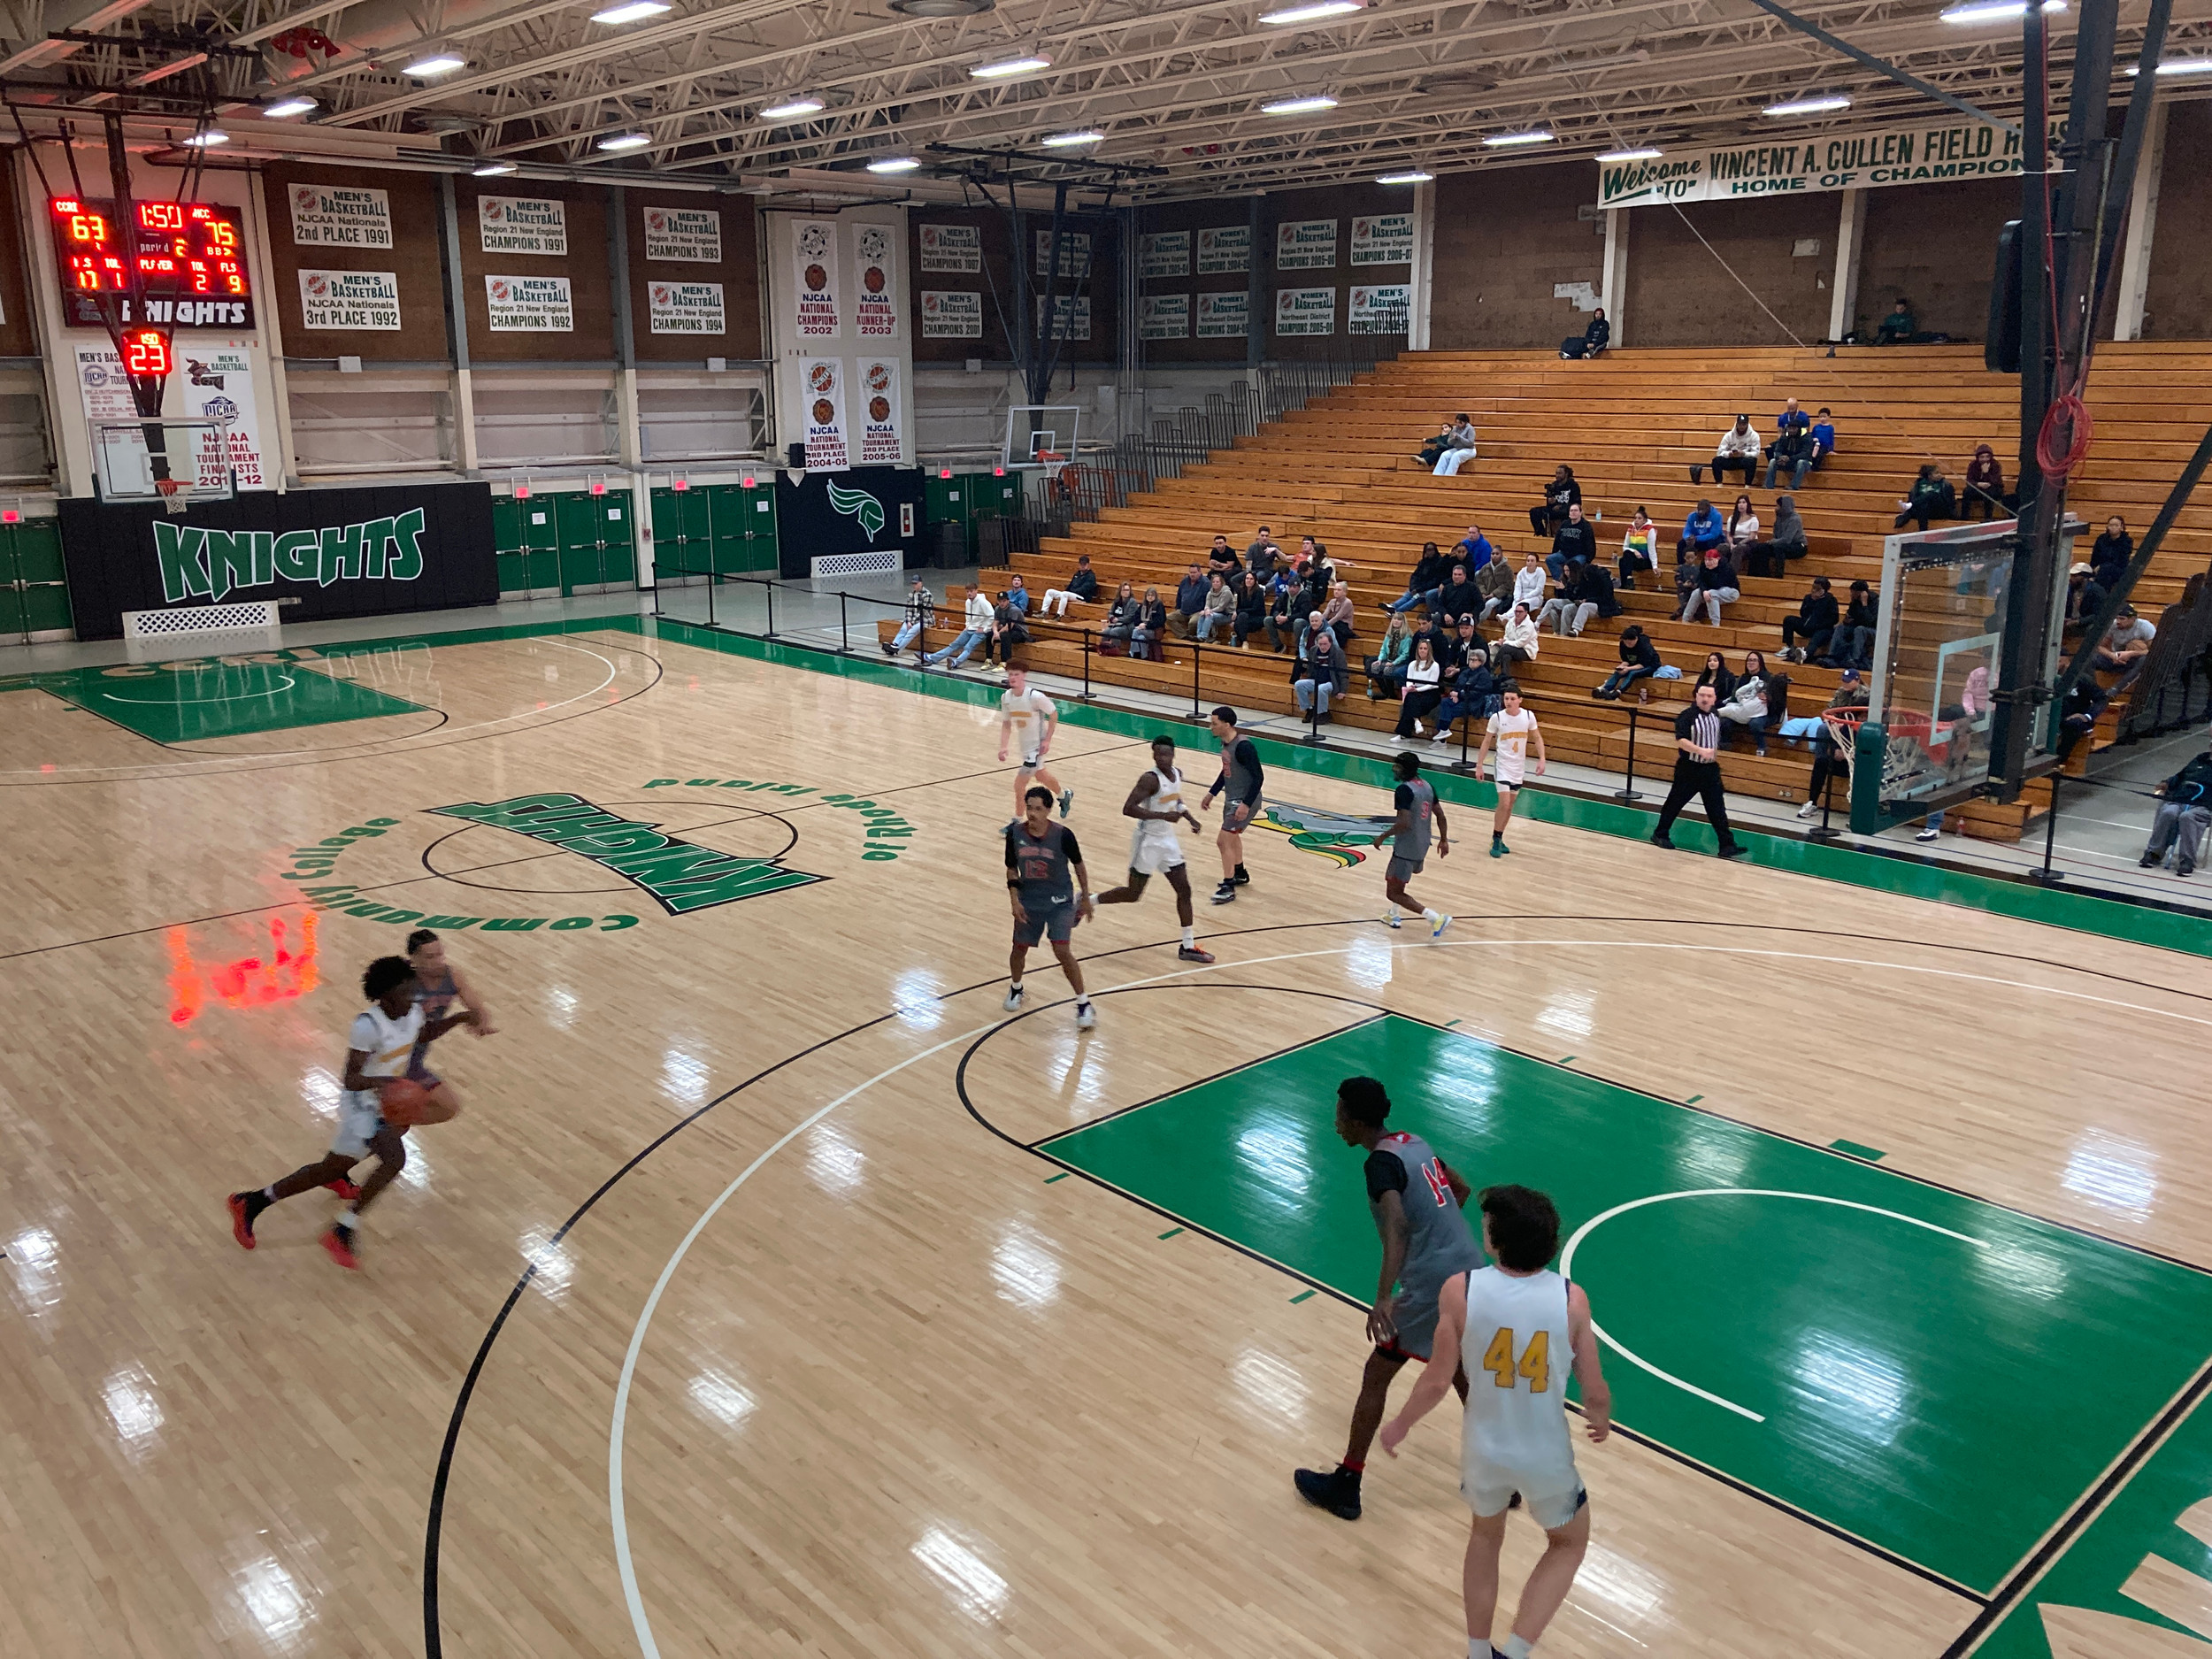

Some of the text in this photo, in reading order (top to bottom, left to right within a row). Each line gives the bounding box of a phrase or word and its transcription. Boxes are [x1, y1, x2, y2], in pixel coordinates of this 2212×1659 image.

[1710, 147, 1799, 180] VINCENT
[1802, 145, 1821, 173] A.
[1828, 133, 1913, 171] CULLEN
[1924, 126, 1993, 162] FIELD
[1604, 159, 1701, 200] Welcome TO
[1732, 178, 1806, 195] HOME
[1820, 173, 1857, 187] OF
[334, 191, 372, 203] MEN'S
[321, 196, 387, 217] BASKETBALL
[517, 202, 550, 211] MEN'S
[297, 214, 386, 227] NJCAA Nationals
[506, 206, 563, 226] BASKETBALL
[678, 212, 707, 223] MEN'S
[72, 216, 104, 240] 63
[483, 225, 507, 236] Region
[536, 227, 564, 236] England
[668, 217, 718, 234] BASKETBALL
[1372, 223, 1412, 238] BASKETBALL
[205, 222, 233, 245] 75
[296, 225, 389, 244] 2nd PLACE 1991
[1296, 228, 1335, 242] BASKETBALL
[484, 235, 565, 251] CHAMPIONS 1991
[939, 233, 978, 248] BASKETBALL
[140, 243, 169, 253] perid
[649, 245, 718, 259] CHAMPIONS 1993
[923, 257, 963, 269] CHAMPIONS
[1279, 257, 1309, 268] CHAMPIONS
[1353, 250, 1385, 263] CHAMPIONS
[191, 261, 206, 271] TOL
[220, 263, 237, 273] FLS
[196, 274, 206, 290] 2
[229, 276, 241, 292] 9
[343, 275, 381, 286] MEN'S
[524, 280, 557, 290] MEN'S
[331, 281, 396, 299] BASKETBALL
[513, 285, 568, 303] BASKETBALL
[672, 291, 721, 307] BASKETBALL
[1295, 296, 1333, 310] BASKETBALL
[490, 304, 514, 314] Region
[542, 305, 569, 314] England
[800, 303, 833, 313] NATIONAL
[859, 303, 892, 314] NATIONAL
[941, 299, 979, 313] BASKETBALL
[307, 310, 397, 326] 3rd PLACE 1992
[491, 315, 571, 328] CHAMPIONS 1992
[797, 315, 837, 326] CHAMPIONS
[856, 315, 895, 326] RUNNER-UP
[653, 319, 722, 331] CHAMPIONS 1994
[925, 324, 964, 334] CHAMPIONS
[1278, 323, 1308, 334] CHAMPIONS
[80, 352, 102, 363] MEN'S
[130, 345, 165, 371] 23
[204, 444, 250, 453] NATONAL
[196, 453, 259, 463] TOURAMENT
[807, 458, 848, 467] 2004-05
[200, 464, 258, 474] FINAISTS
[199, 475, 262, 486] 201-12
[152, 507, 425, 603] KNIGHTS
[280, 779, 918, 933] Community College of Rhode Island
[420, 793, 833, 915] KNIGHTS
[1483, 1327, 1549, 1394] 44
